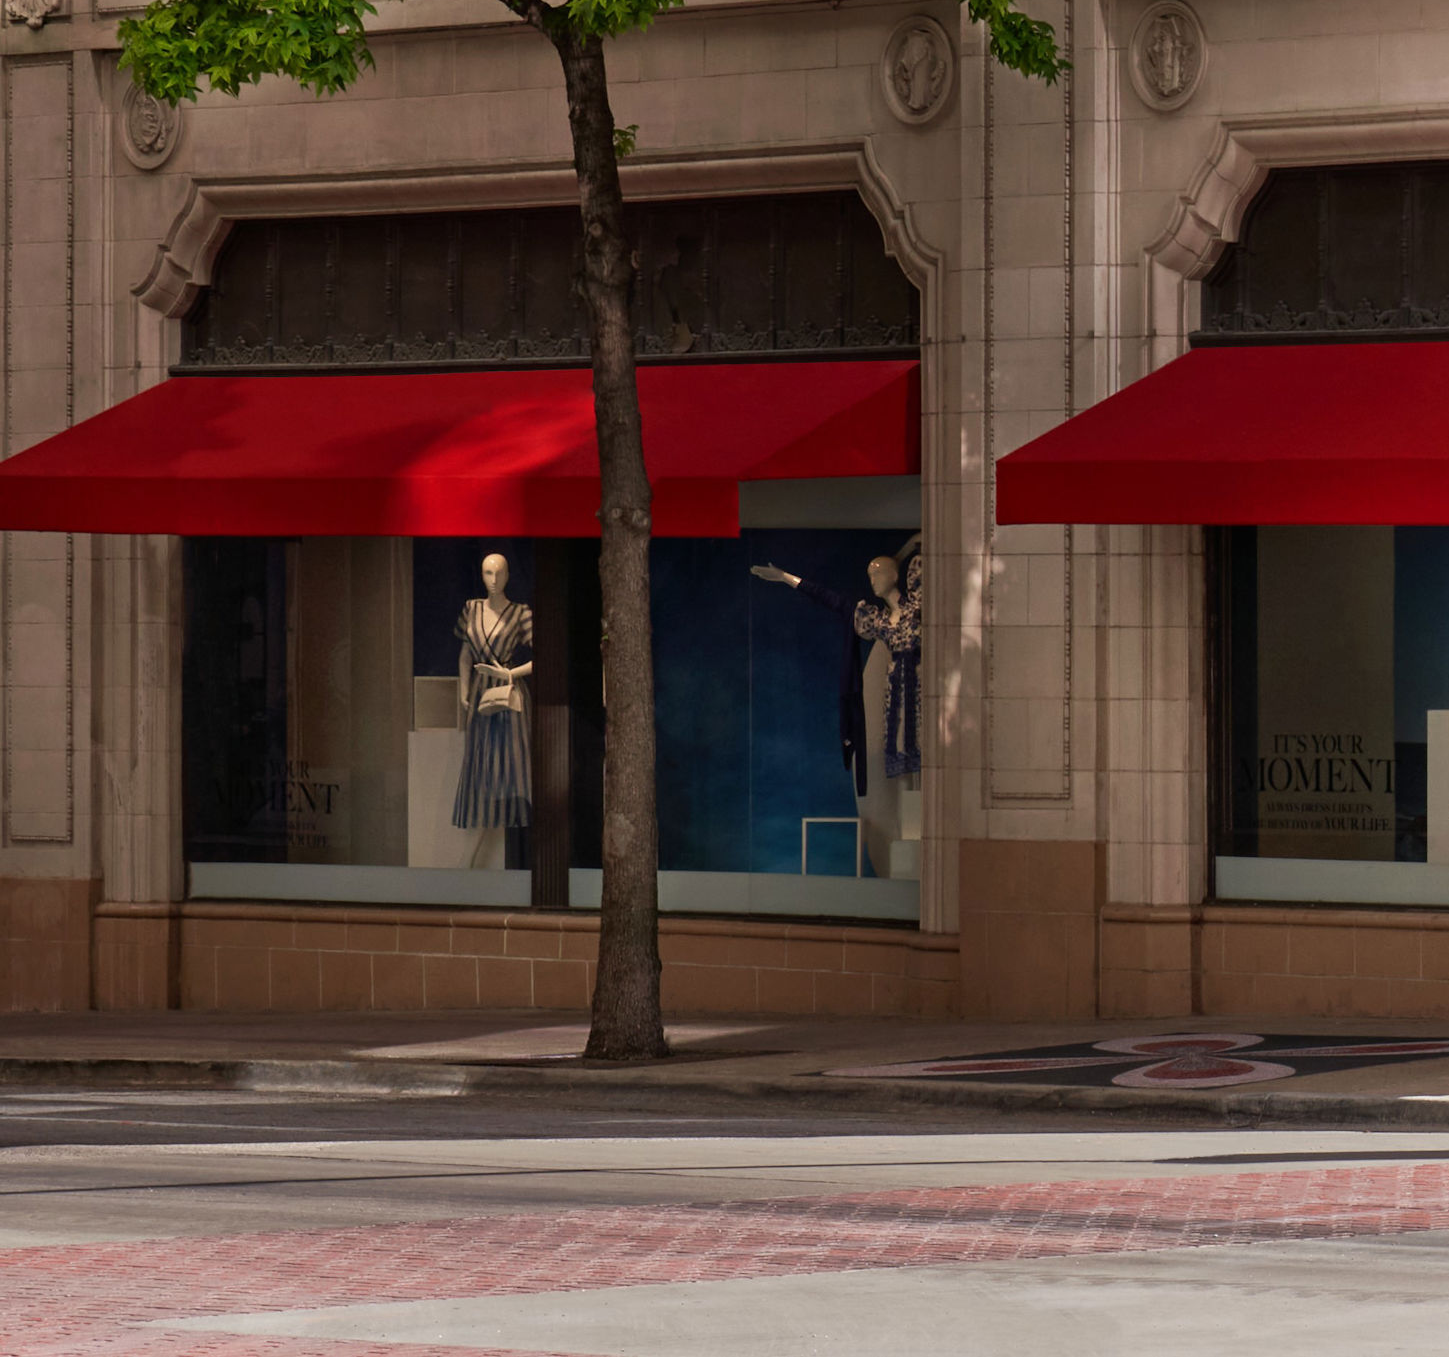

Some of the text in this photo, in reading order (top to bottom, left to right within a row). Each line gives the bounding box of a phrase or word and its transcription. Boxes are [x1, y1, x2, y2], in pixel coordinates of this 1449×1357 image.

[1273, 733, 1364, 754] IT'S YOUR
[1240, 756, 1399, 794] MOMENT
[1324, 817, 1359, 831] YOUR
